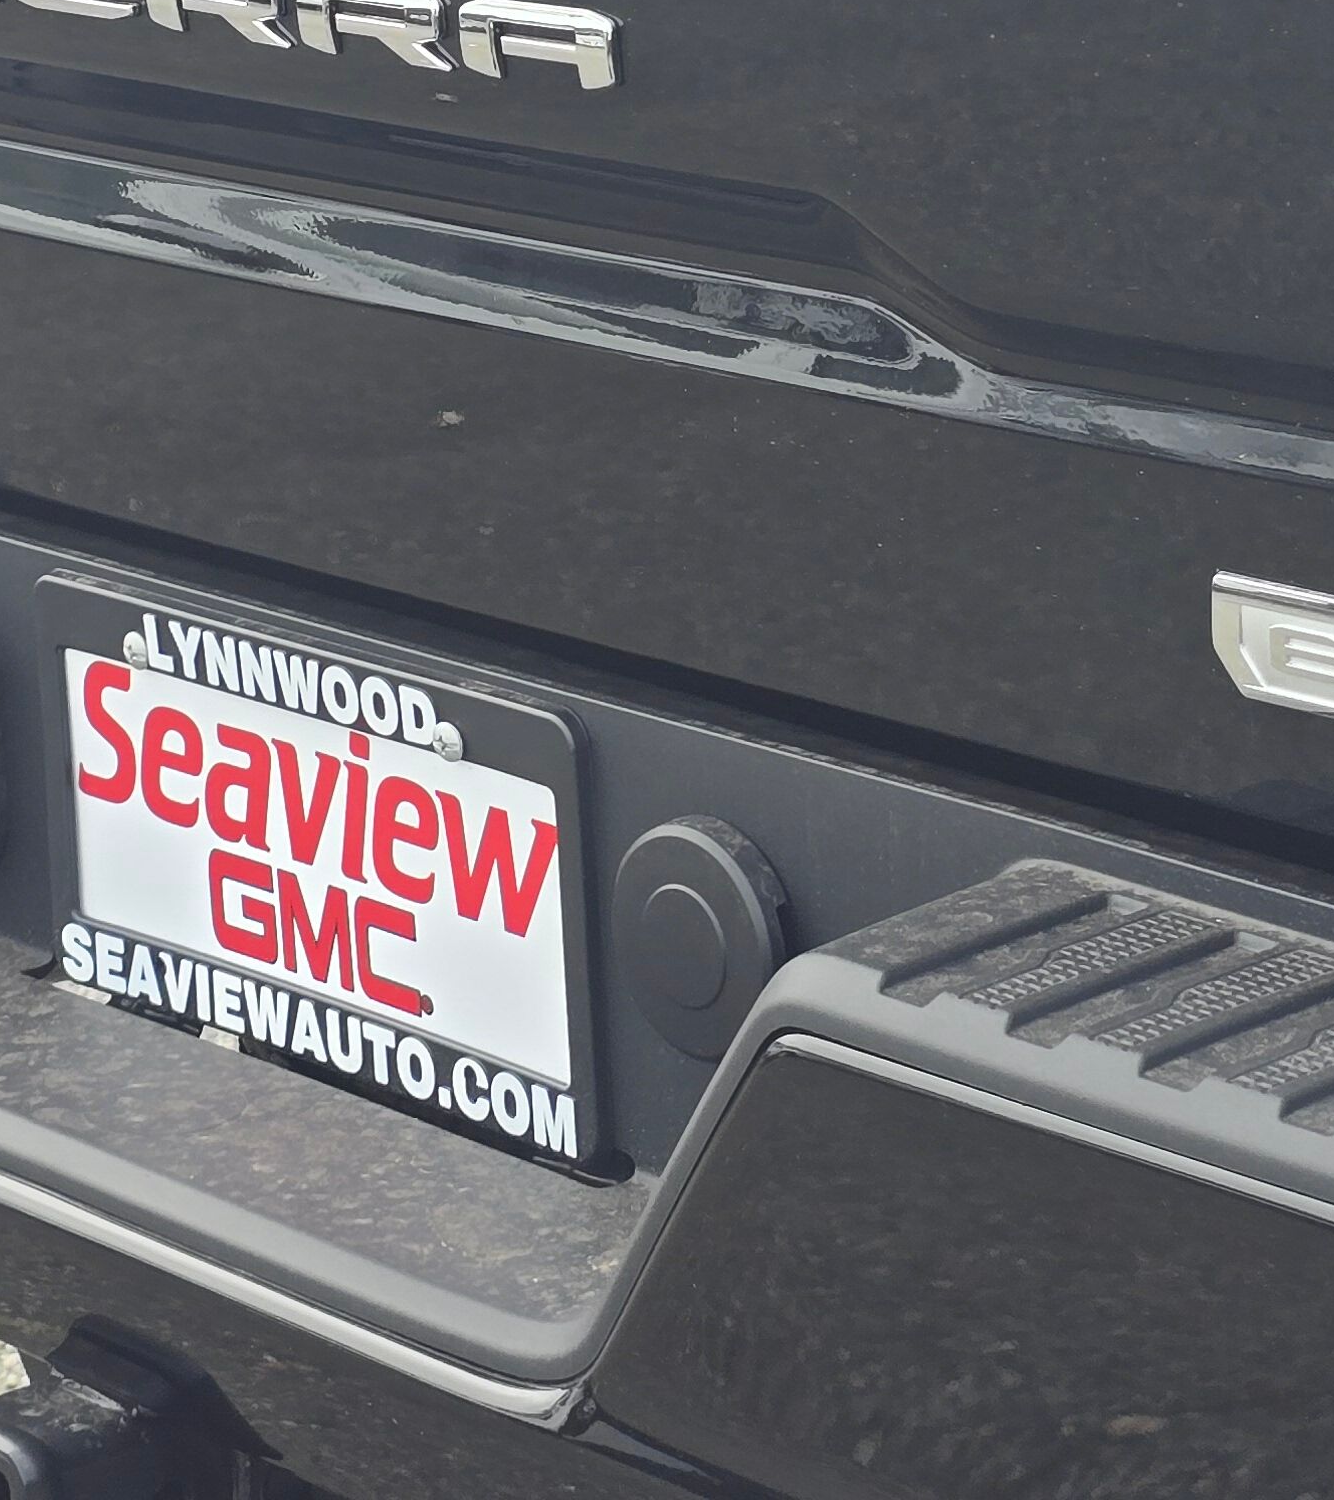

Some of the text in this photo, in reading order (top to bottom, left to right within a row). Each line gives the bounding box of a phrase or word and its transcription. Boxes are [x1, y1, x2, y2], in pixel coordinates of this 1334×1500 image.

[142, 613, 438, 747] LYNNWOOD
[78, 661, 558, 938] Seaview
[208, 848, 424, 1017] GMC
[61, 923, 579, 1158] SEAVIEWAUTO.COM
